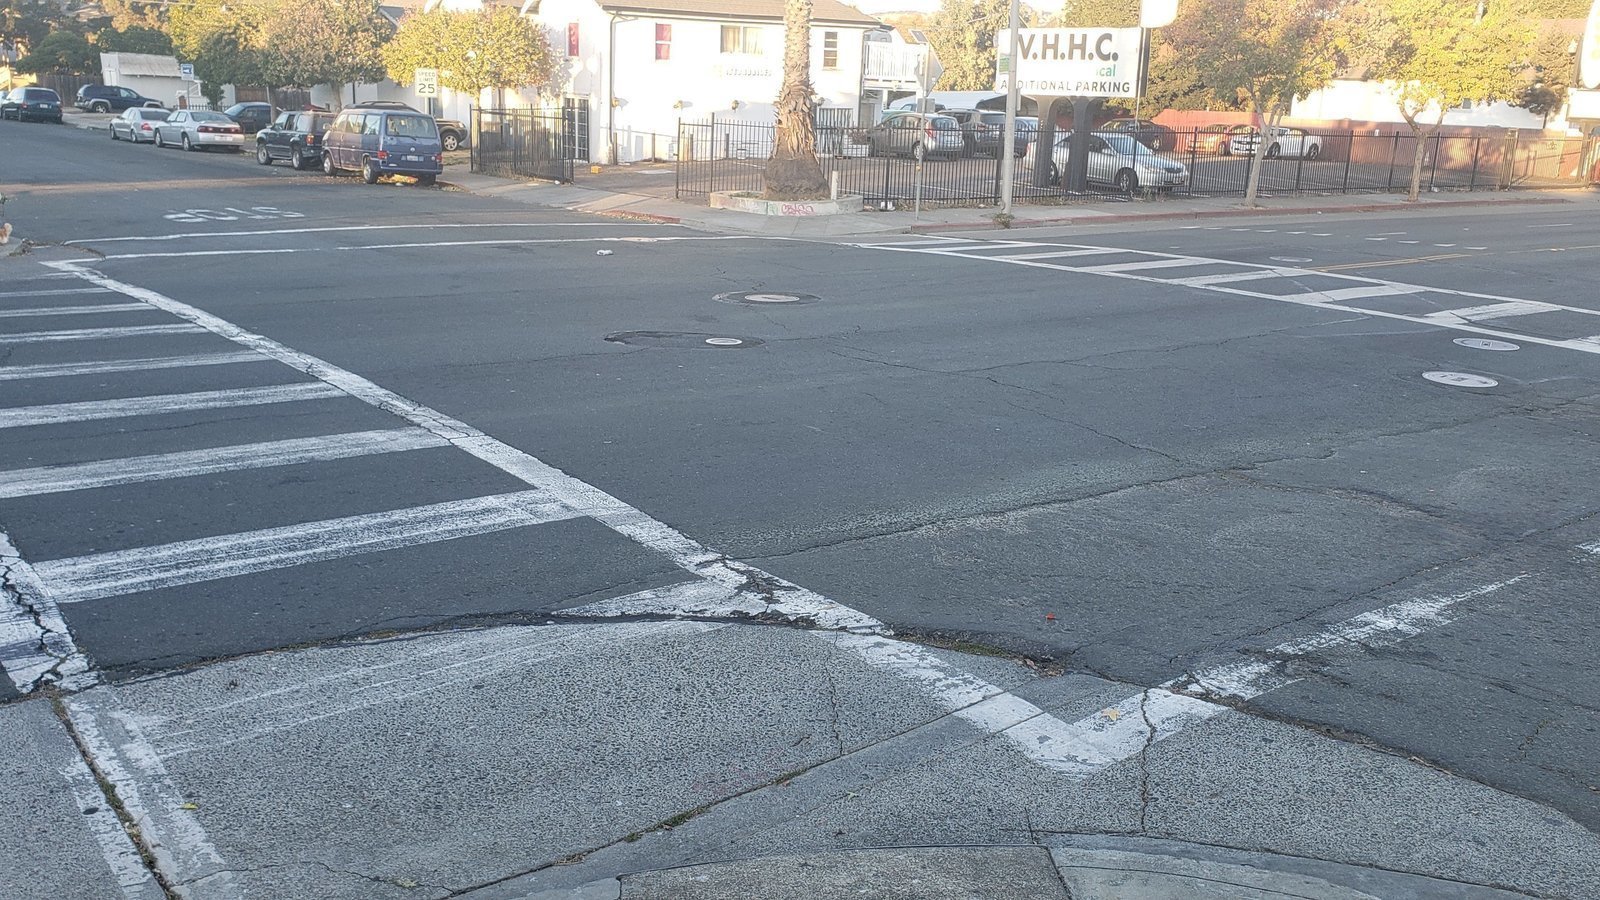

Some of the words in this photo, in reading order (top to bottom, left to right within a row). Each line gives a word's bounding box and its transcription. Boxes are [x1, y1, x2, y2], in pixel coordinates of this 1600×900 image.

[1018, 33, 1119, 62] V.H.H.C.
[418, 83, 435, 94] 25
[1001, 80, 1071, 92] ADITIONAL
[1075, 81, 1130, 93] PARKING
